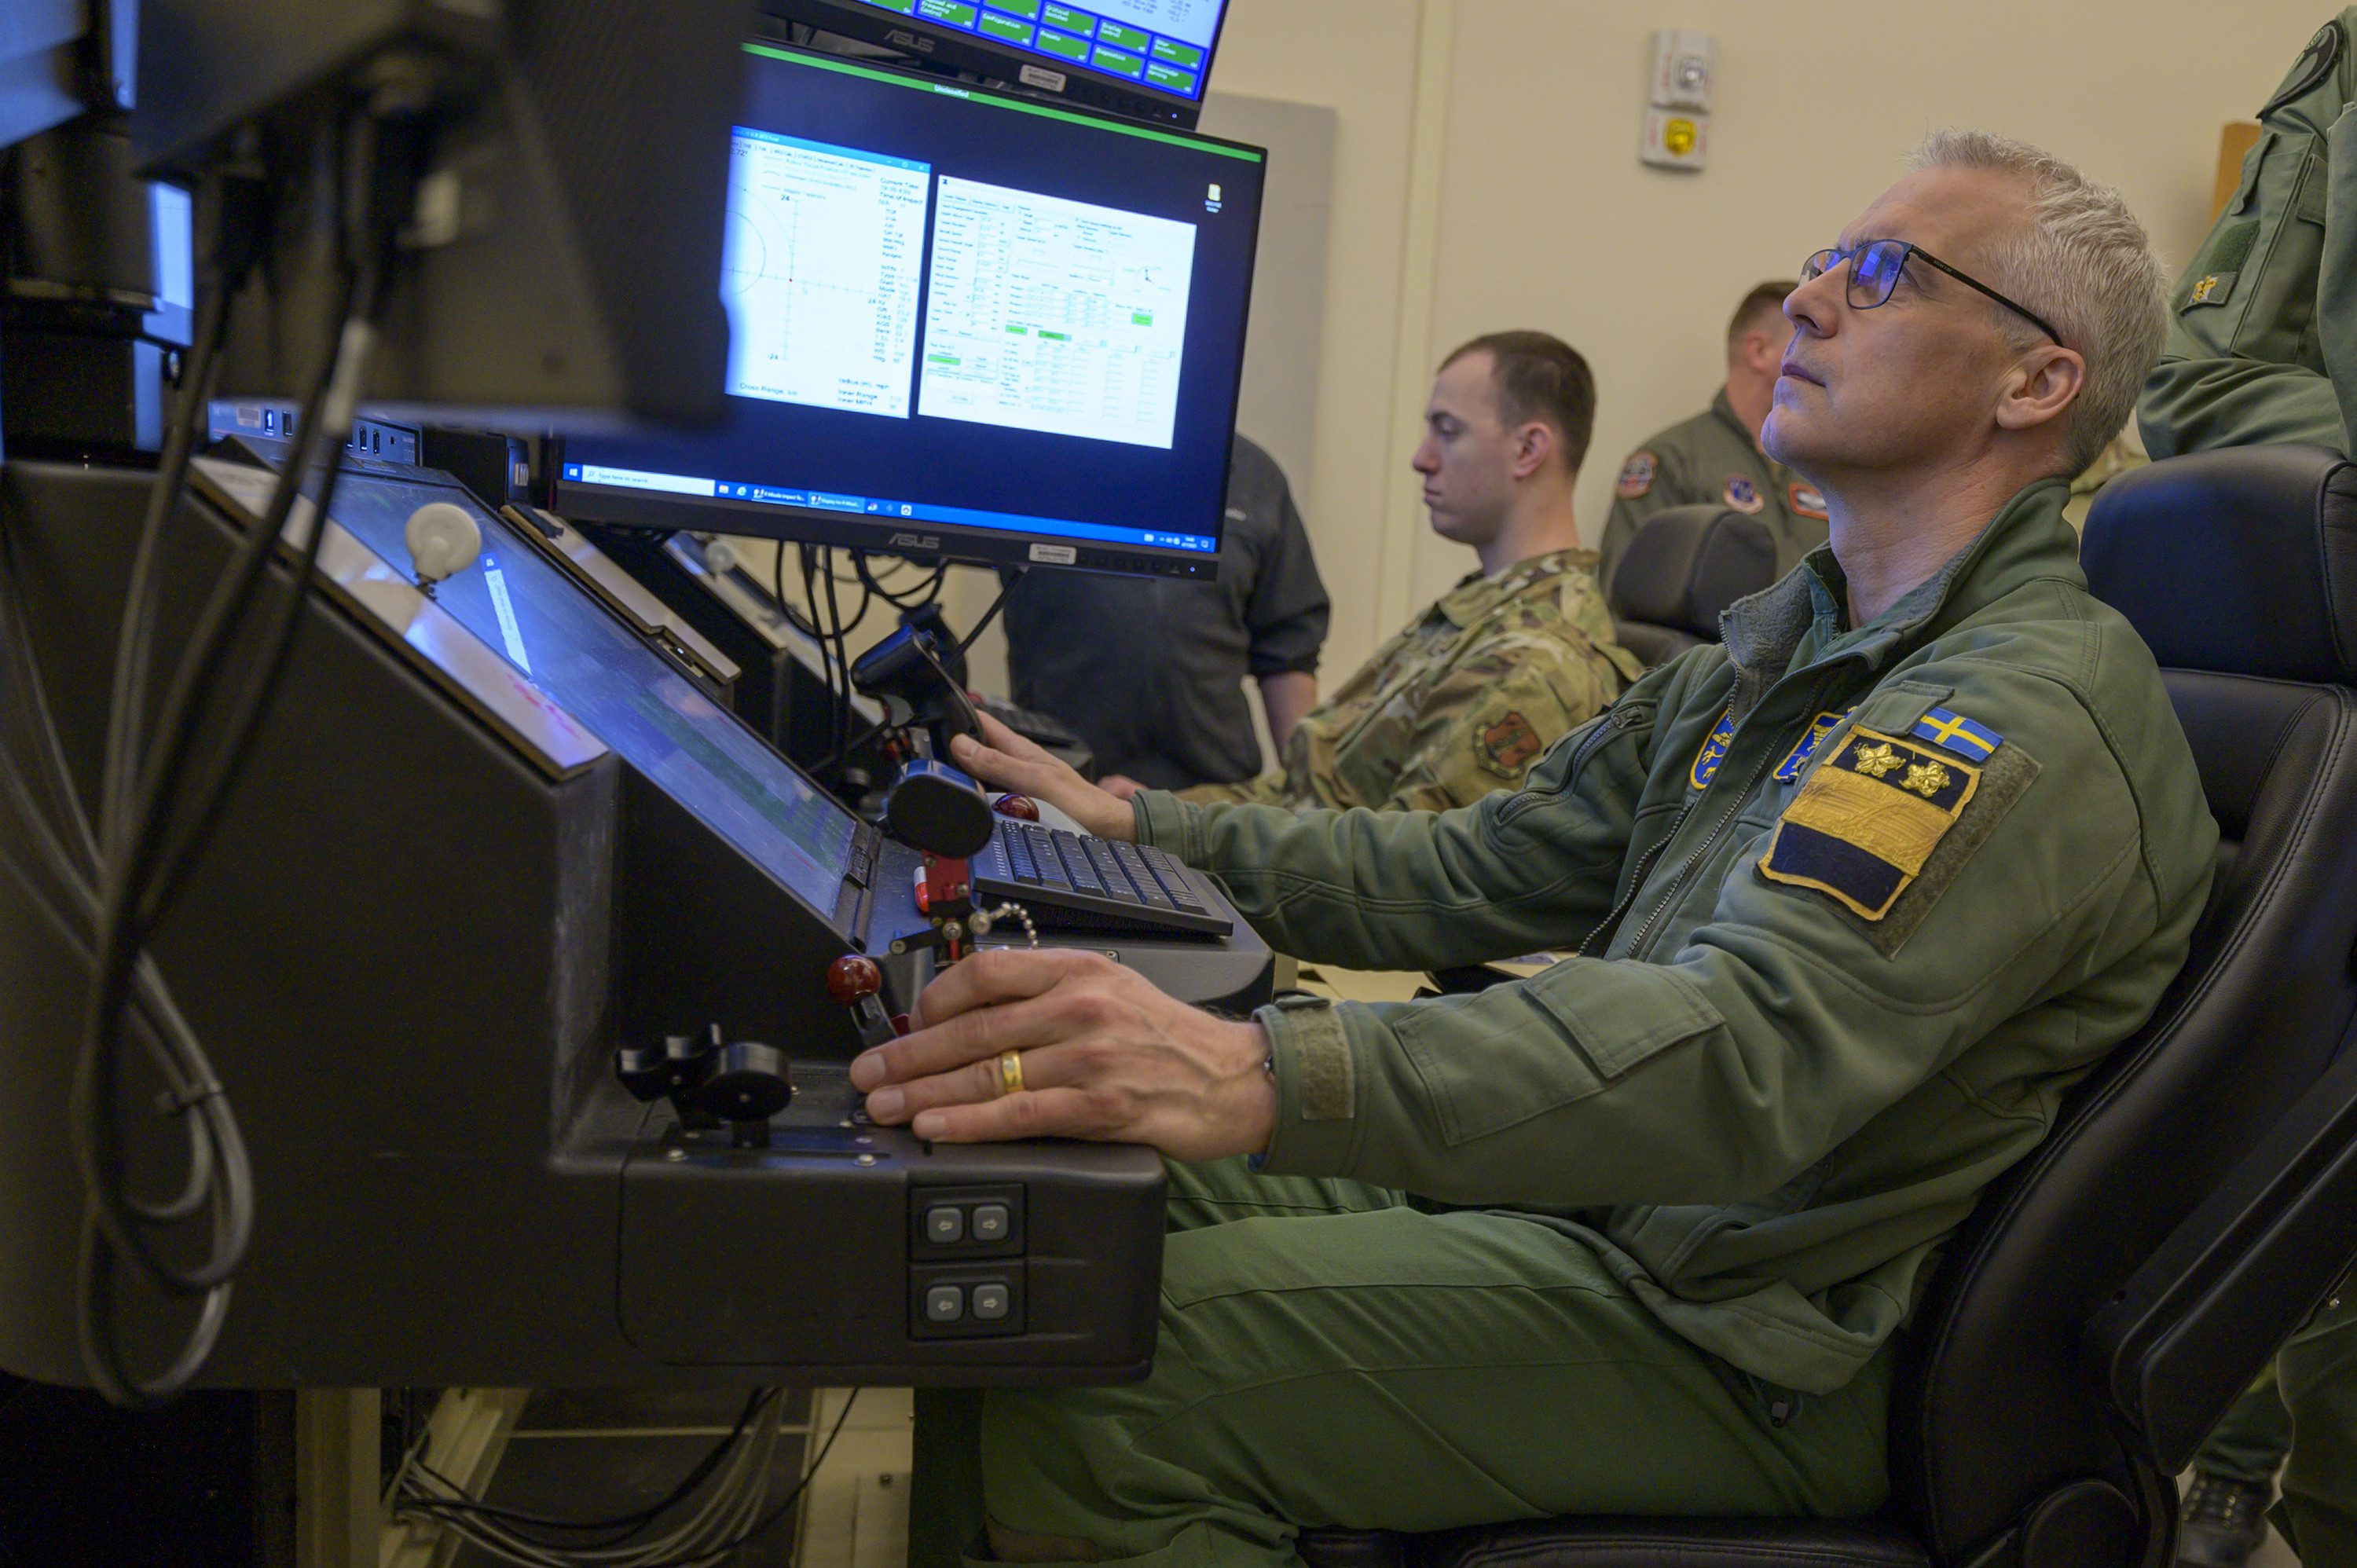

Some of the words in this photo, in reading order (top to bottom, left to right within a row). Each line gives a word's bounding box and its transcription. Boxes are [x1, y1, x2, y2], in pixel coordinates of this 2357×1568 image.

[983, 13, 1021, 29] Configuration
[884, 29, 936, 53] ASUS
[934, 83, 970, 98] Unclassified
[739, 383, 760, 391] Cross
[856, 392, 878, 401] Range
[889, 533, 940, 549] ASUS
